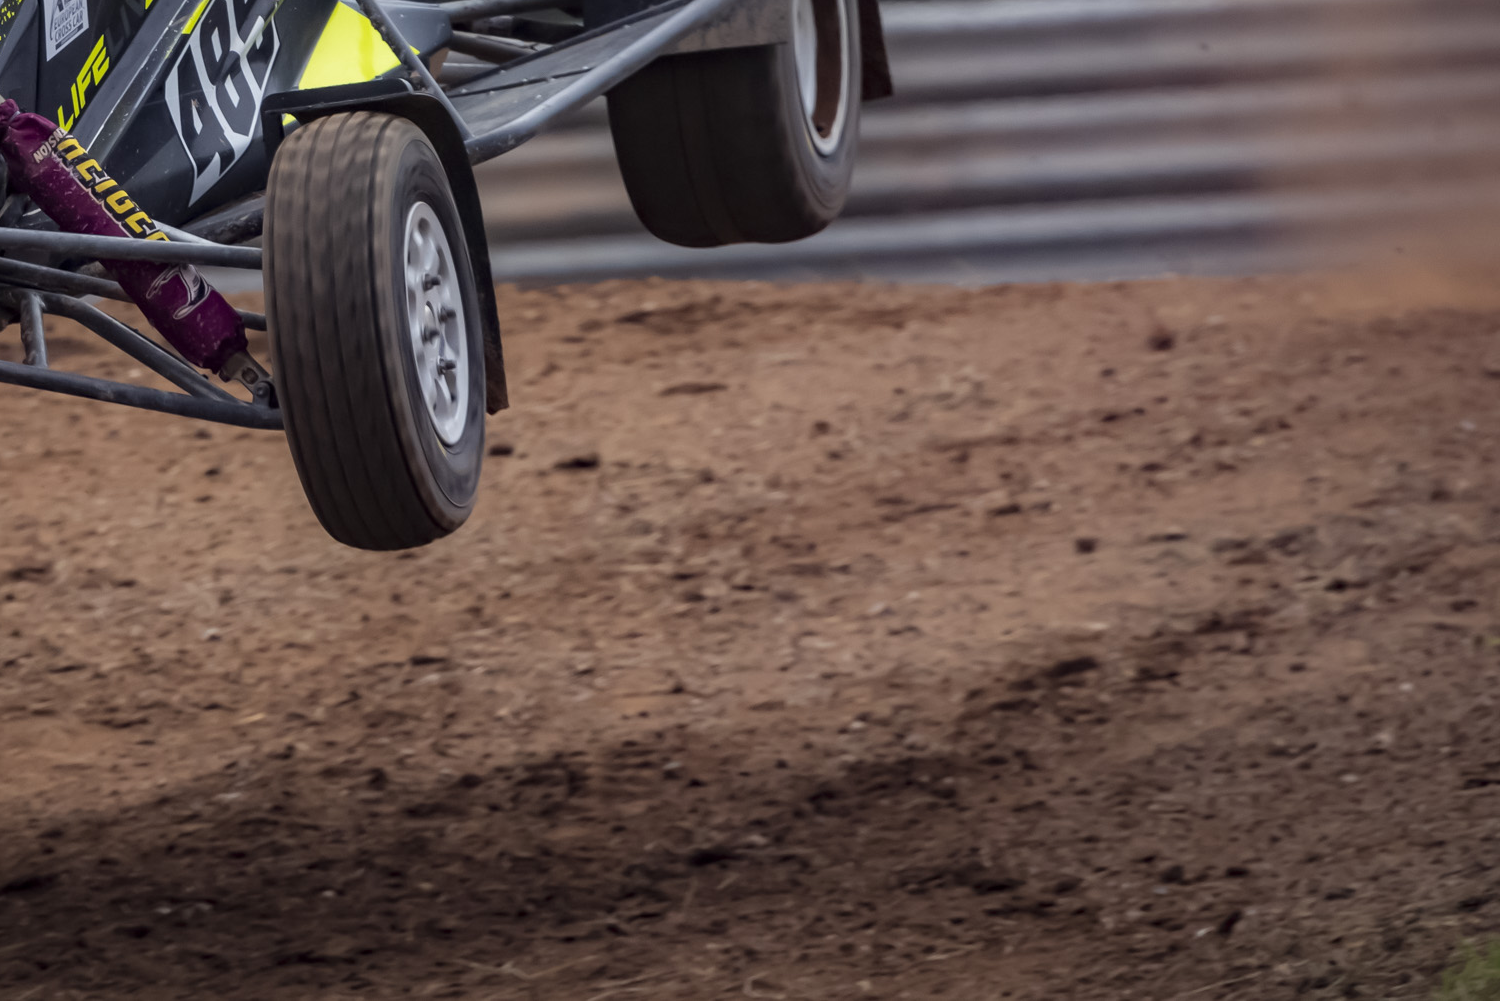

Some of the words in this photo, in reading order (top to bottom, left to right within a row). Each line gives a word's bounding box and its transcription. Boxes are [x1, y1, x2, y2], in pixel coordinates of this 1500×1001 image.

[54, 0, 84, 31] EUROPEAN
[55, 21, 72, 43] CROSS
[71, 11, 84, 28] CAR
[58, 34, 109, 132] LIFE
